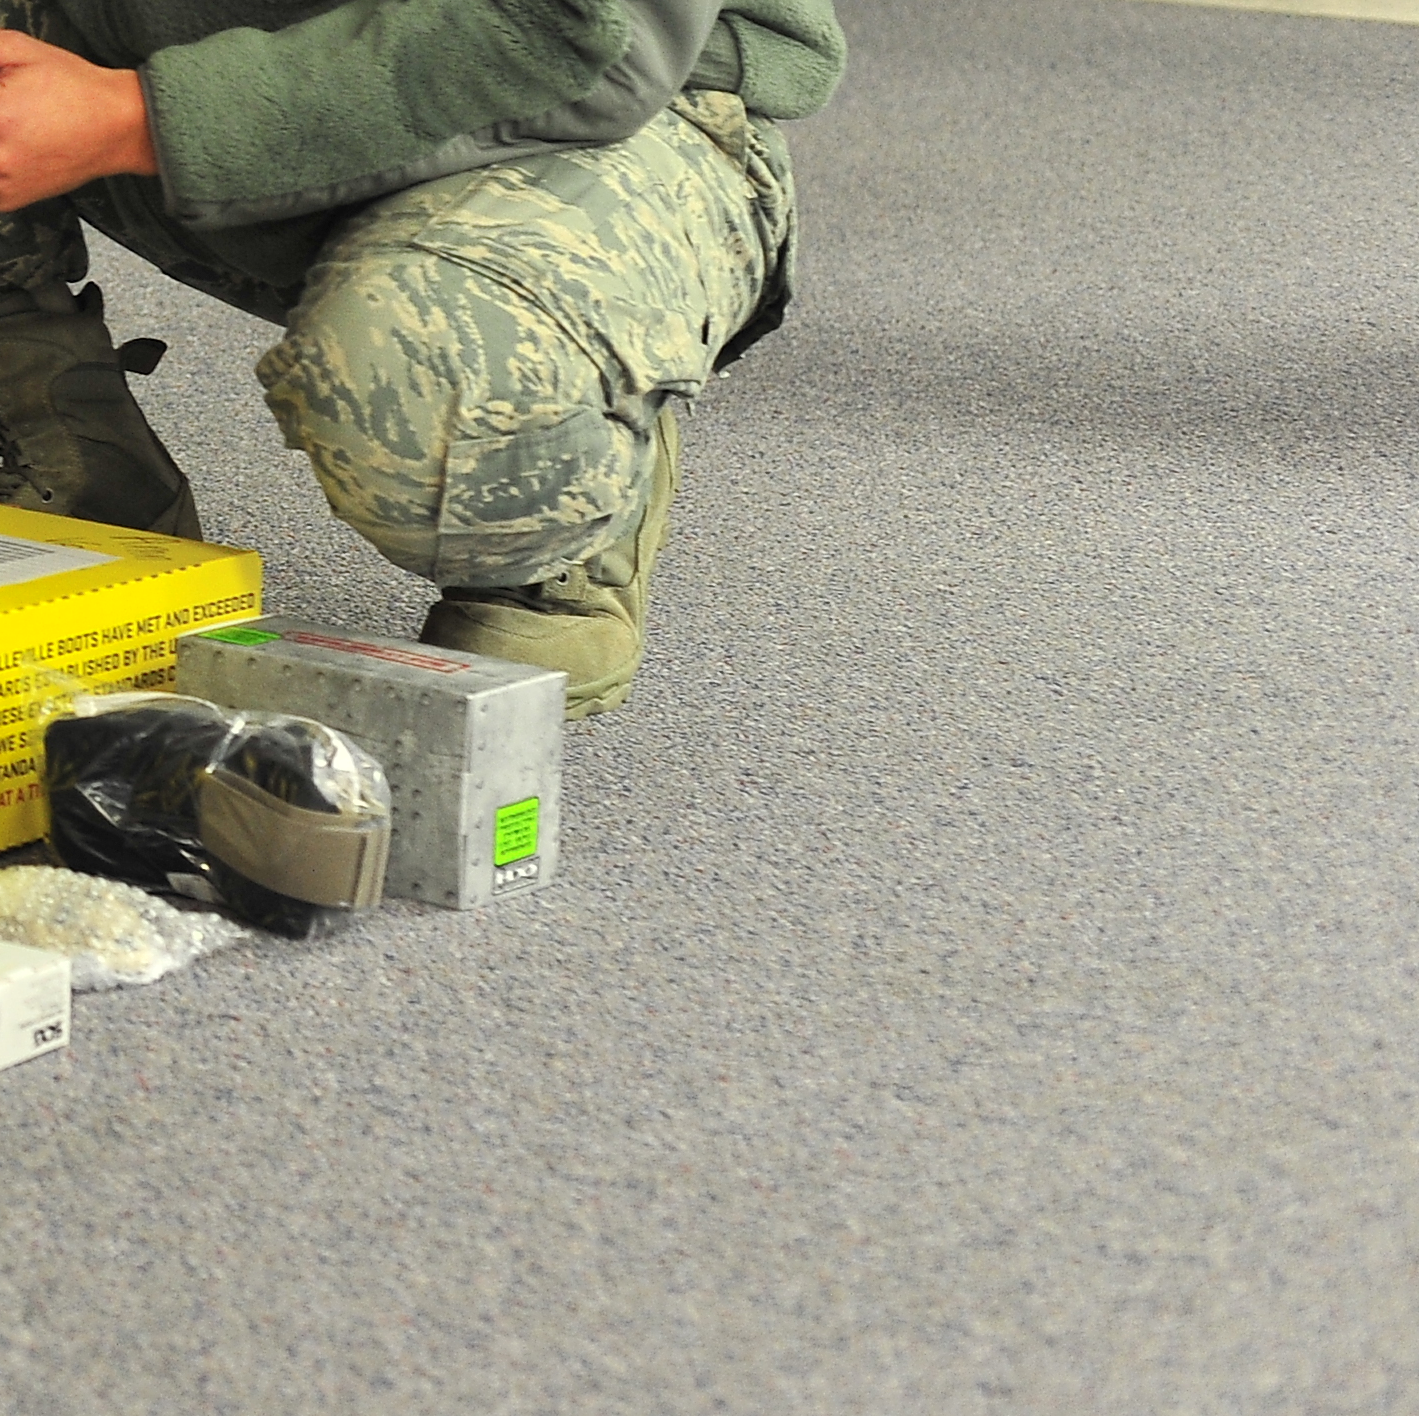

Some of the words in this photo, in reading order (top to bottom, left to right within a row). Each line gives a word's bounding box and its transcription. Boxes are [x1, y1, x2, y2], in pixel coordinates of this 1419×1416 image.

[57, 631, 99, 656] BOOTS
[101, 622, 134, 644] HAVE
[136, 615, 162, 636] MET
[164, 608, 190, 629] AND
[193, 592, 255, 622] EXCEEDED
[123, 648, 138, 667] BY
[142, 640, 166, 661] THE
